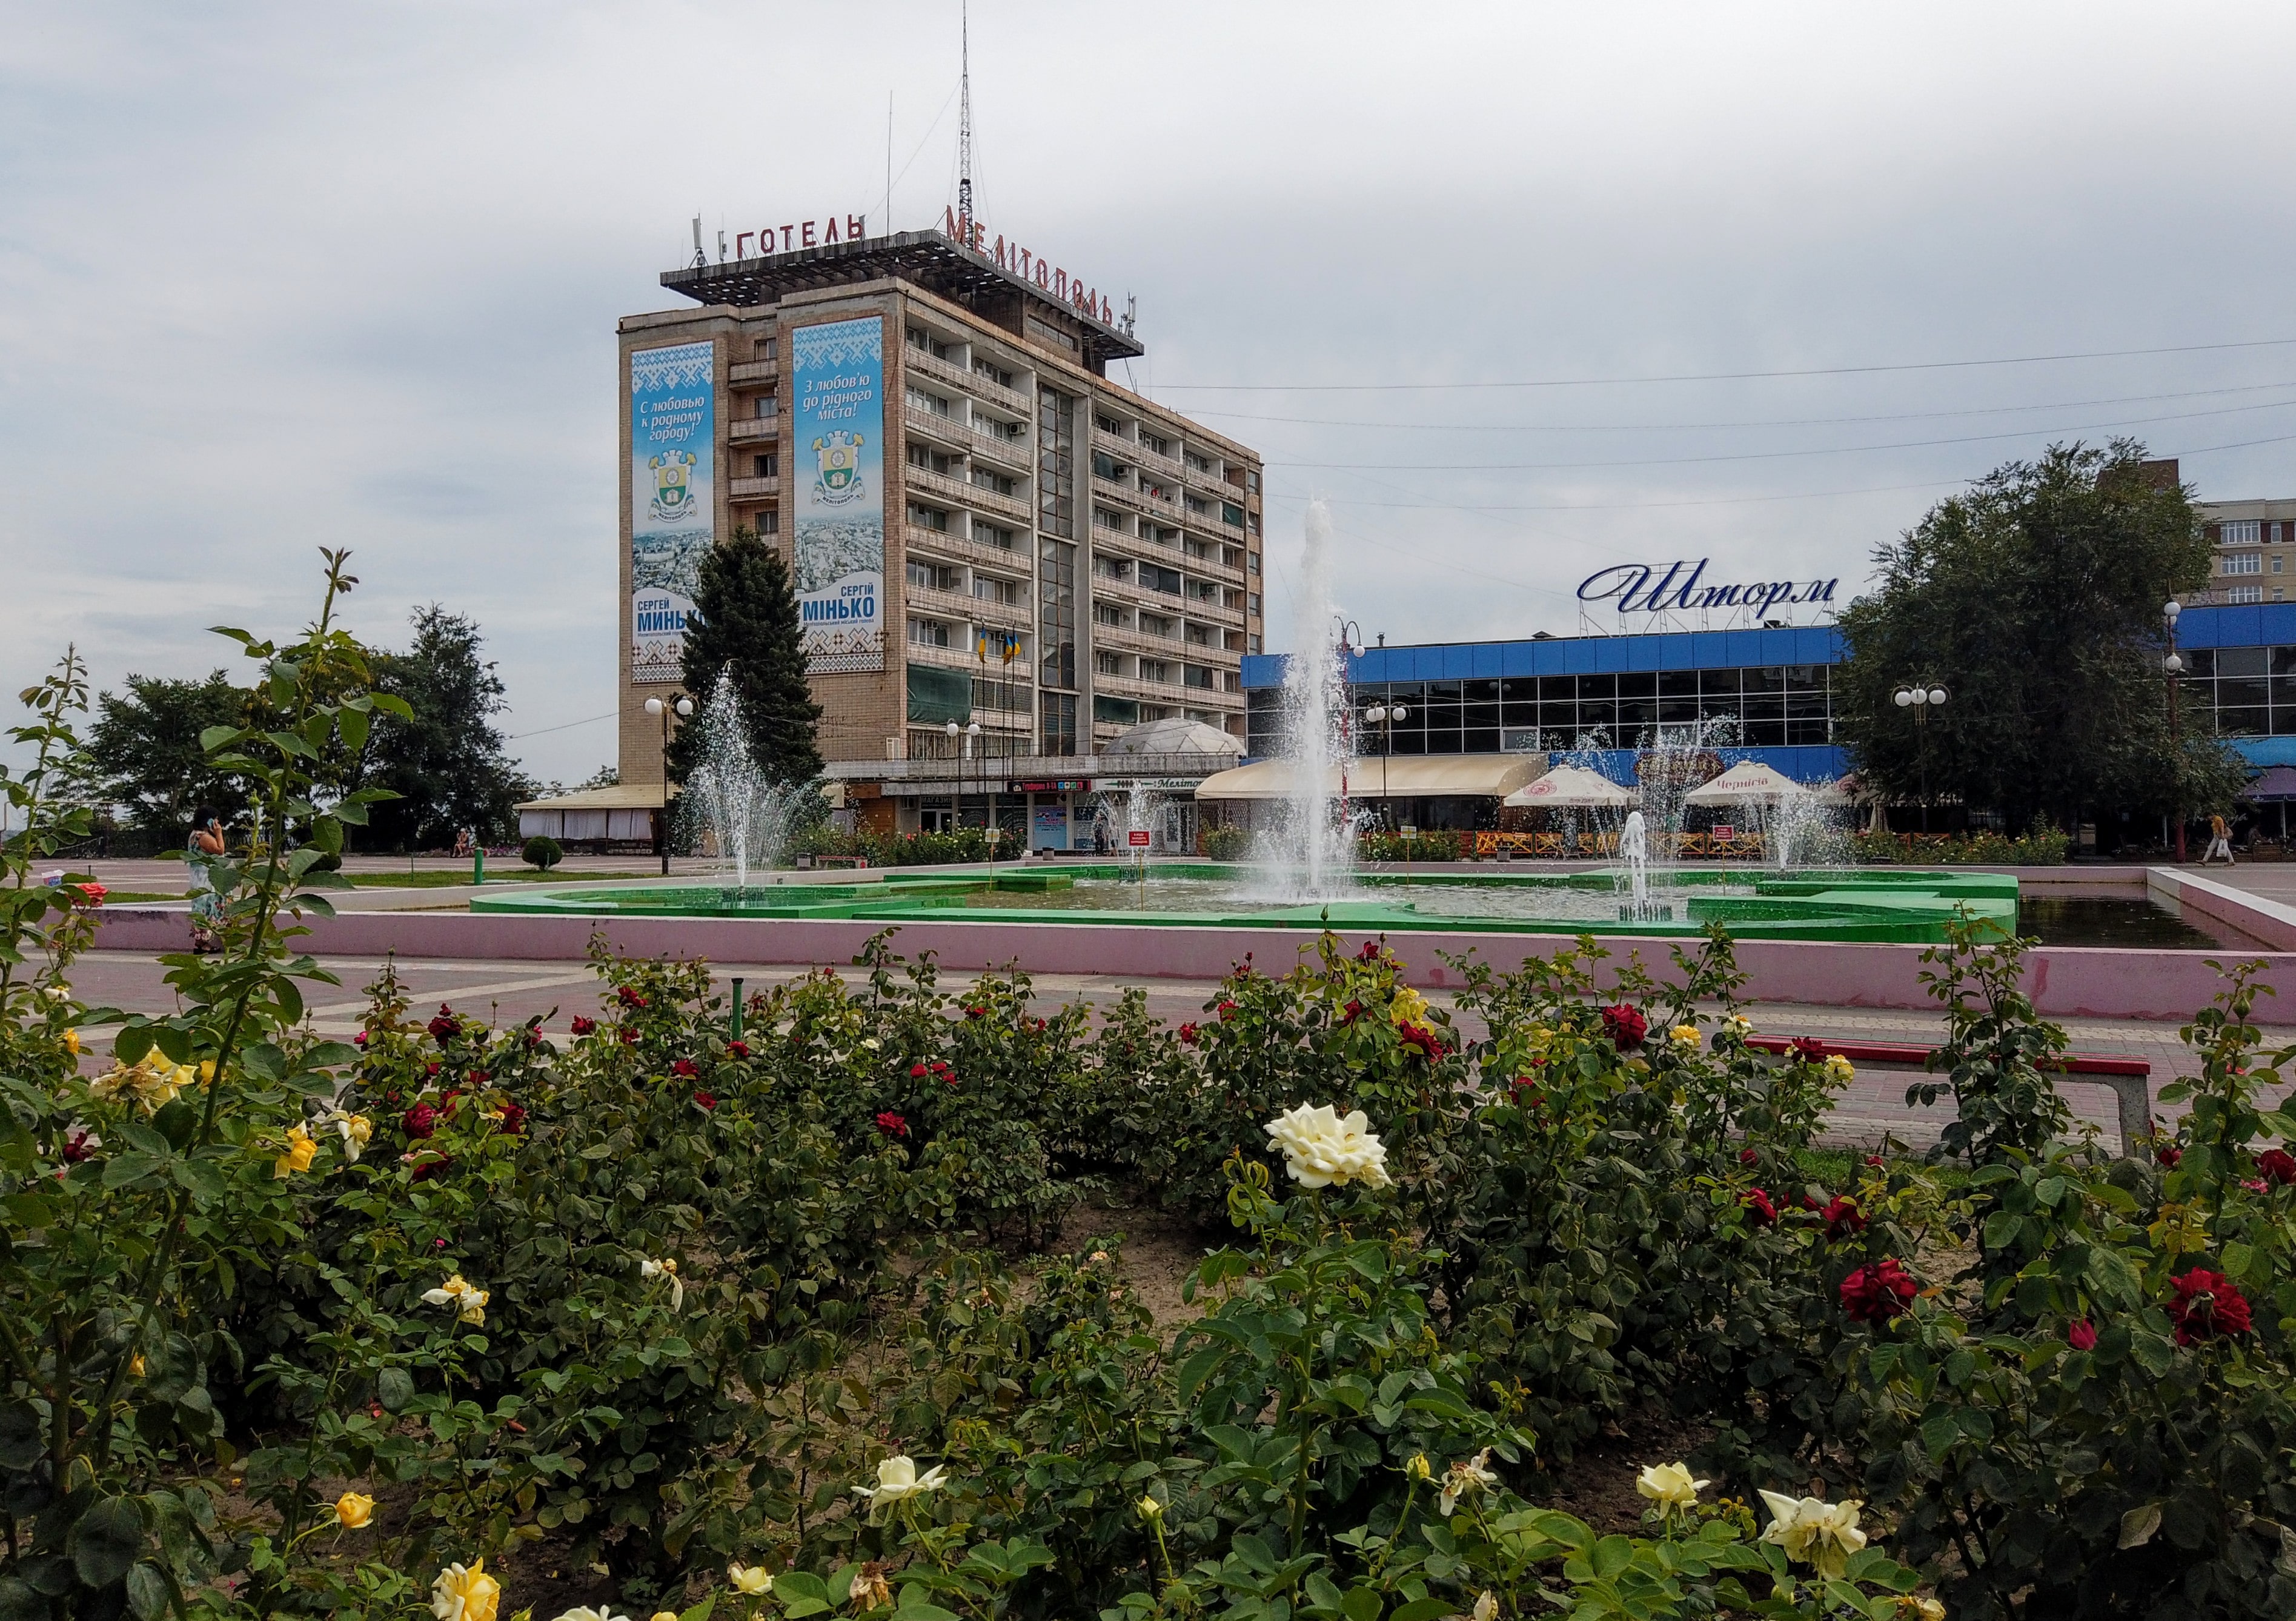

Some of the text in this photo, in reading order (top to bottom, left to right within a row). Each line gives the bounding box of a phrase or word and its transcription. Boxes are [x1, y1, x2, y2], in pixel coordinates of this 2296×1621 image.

[736, 214, 863, 259] ГОТЕЛЬ
[946, 205, 1113, 327] МЕЛІТОПОЛЬ
[805, 380, 812, 393] З
[640, 396, 705, 414] С любовью
[803, 390, 872, 413] до рідного
[817, 402, 858, 421] міста!
[642, 411, 704, 431] к родному
[649, 422, 695, 444] городу!
[822, 494, 854, 505] МЕЛІТОПОЛЬ
[841, 582, 874, 597] СЕРГІЙ
[1576, 558, 1839, 620] Шторм
[637, 597, 669, 611] СЕРГЕЙ
[803, 596, 875, 621] МІНЬКО
[637, 609, 706, 631] МИНЬ
[1717, 777, 1768, 791] Чернігів
